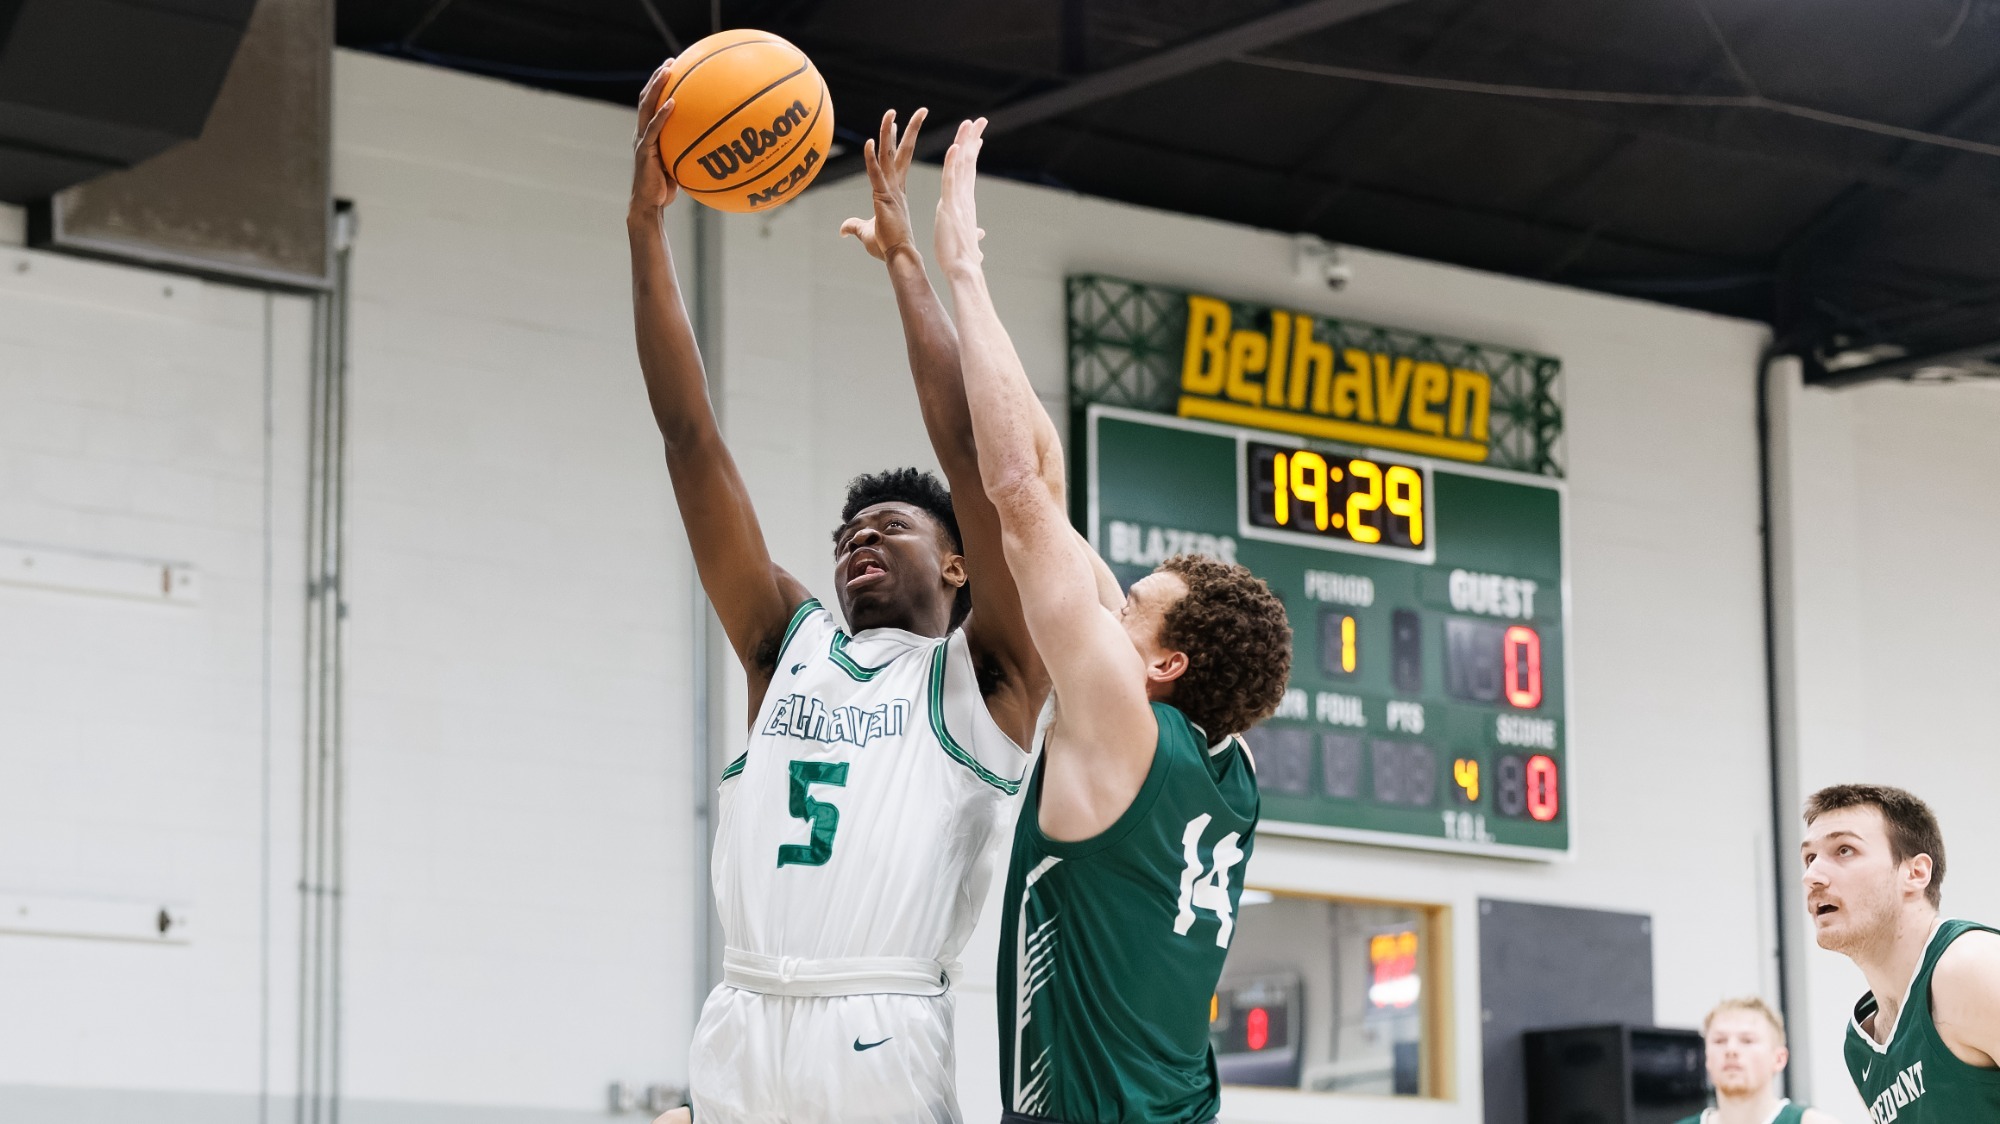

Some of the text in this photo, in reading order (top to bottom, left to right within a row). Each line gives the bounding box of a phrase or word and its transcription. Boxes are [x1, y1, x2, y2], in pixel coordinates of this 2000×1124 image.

[697, 100, 809, 181] Wilson
[747, 147, 820, 207] NCAA
[1181, 295, 1492, 441] Belhaven
[1273, 450, 1424, 546] 19:29
[1304, 569, 1375, 608] PERIOD
[1449, 568, 1538, 619] GUEST
[1341, 616, 1357, 673] 1
[1504, 625, 1542, 709] 0
[1315, 691, 1368, 728] FOUL
[1386, 700, 1426, 734] PTS
[1496, 713, 1557, 750] SCORE
[1454, 758, 1479, 802] 4
[1526, 754, 1558, 821] 0
[777, 760, 849, 868] 5
[1173, 812, 1245, 949] 14
